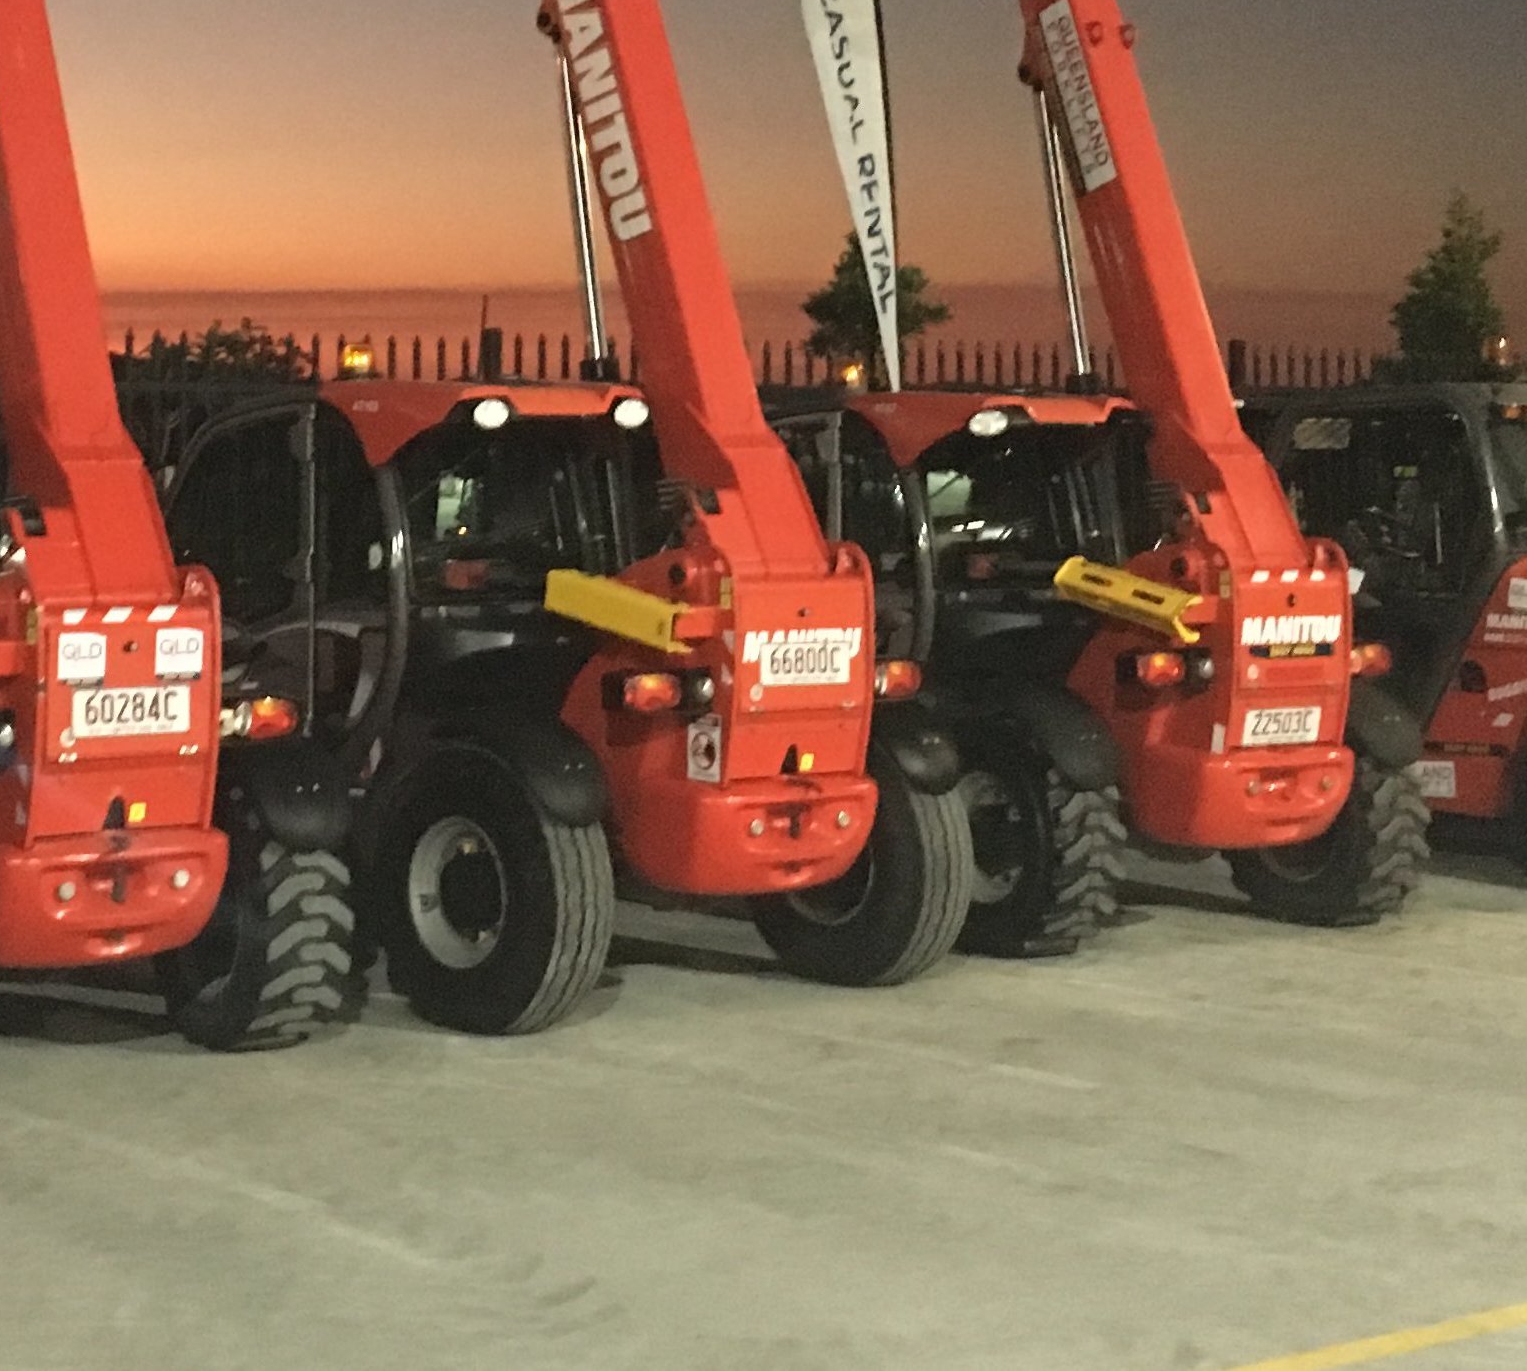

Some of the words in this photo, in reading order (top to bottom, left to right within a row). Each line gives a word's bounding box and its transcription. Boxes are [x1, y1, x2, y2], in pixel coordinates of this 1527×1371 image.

[1057, 15, 1109, 168] QUEENSLAND
[857, 153, 894, 314] RENTAL
[1240, 614, 1342, 646] MANITOU
[769, 645, 842, 675] 66800C
[84, 690, 178, 726] 60284C
